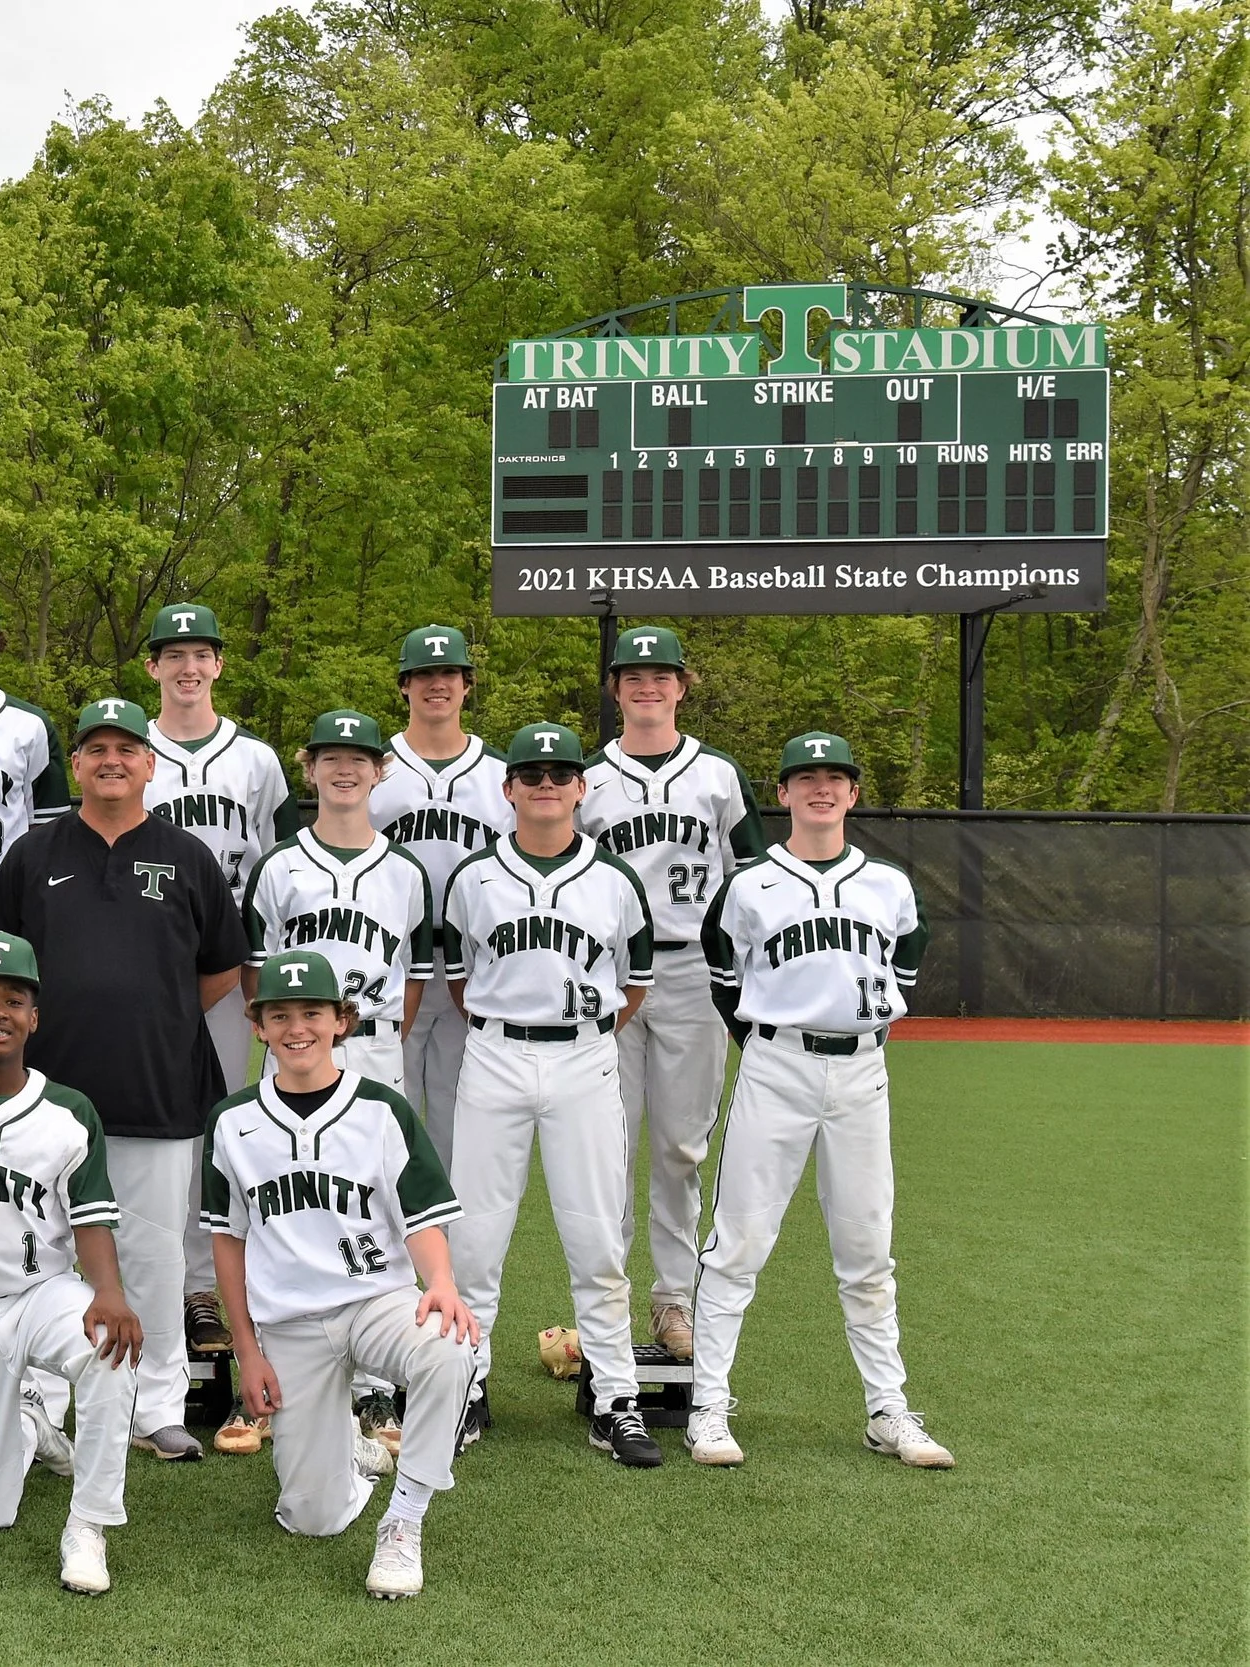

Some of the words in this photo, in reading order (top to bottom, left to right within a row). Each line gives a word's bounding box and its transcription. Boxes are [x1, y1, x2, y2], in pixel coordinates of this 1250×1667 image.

[743, 283, 847, 376] T
[512, 336, 755, 380] TRINITY
[833, 326, 1101, 373] STADIUM
[522, 387, 550, 409] AT
[557, 386, 598, 409] BAT
[651, 384, 708, 407] BALL
[754, 380, 834, 405] STRIKE
[886, 378, 934, 401] OUT
[1017, 375, 1056, 400] H/E
[498, 454, 566, 464] DAKTRONICS
[610, 451, 618, 469] 1
[638, 451, 648, 469] 2
[667, 451, 678, 468] 3
[704, 450, 715, 466] 4
[734, 449, 746, 467] 5
[765, 449, 776, 466] 6
[803, 448, 814, 465] 7
[833, 447, 844, 466] 8
[863, 447, 874, 465] 9
[897, 446, 918, 464] 10
[937, 444, 989, 463] RUNS
[1009, 443, 1052, 462] HITS
[1066, 442, 1103, 461] ERR
[518, 568, 577, 592] 2021
[586, 566, 700, 591] KHSAA
[708, 564, 826, 590] Baseball
[835, 563, 907, 589] State
[916, 562, 1080, 592] Champions
[172, 611, 196, 633] T
[424, 636, 449, 656] T
[633, 635, 658, 656] T
[98, 699, 125, 720] T
[334, 717, 360, 738] T
[534, 731, 560, 753] T
[804, 738, 831, 758] T
[134, 861, 175, 901] T
[668, 864, 709, 904] 27
[284, 907, 400, 967] TRINITY
[764, 916, 890, 970] TRINITY
[279, 963, 310, 987] T
[341, 968, 388, 1016] 24
[562, 977, 603, 1021] 19
[856, 977, 892, 1021] 13
[22, 1232, 41, 1276] 1
[338, 1233, 389, 1277] 12
